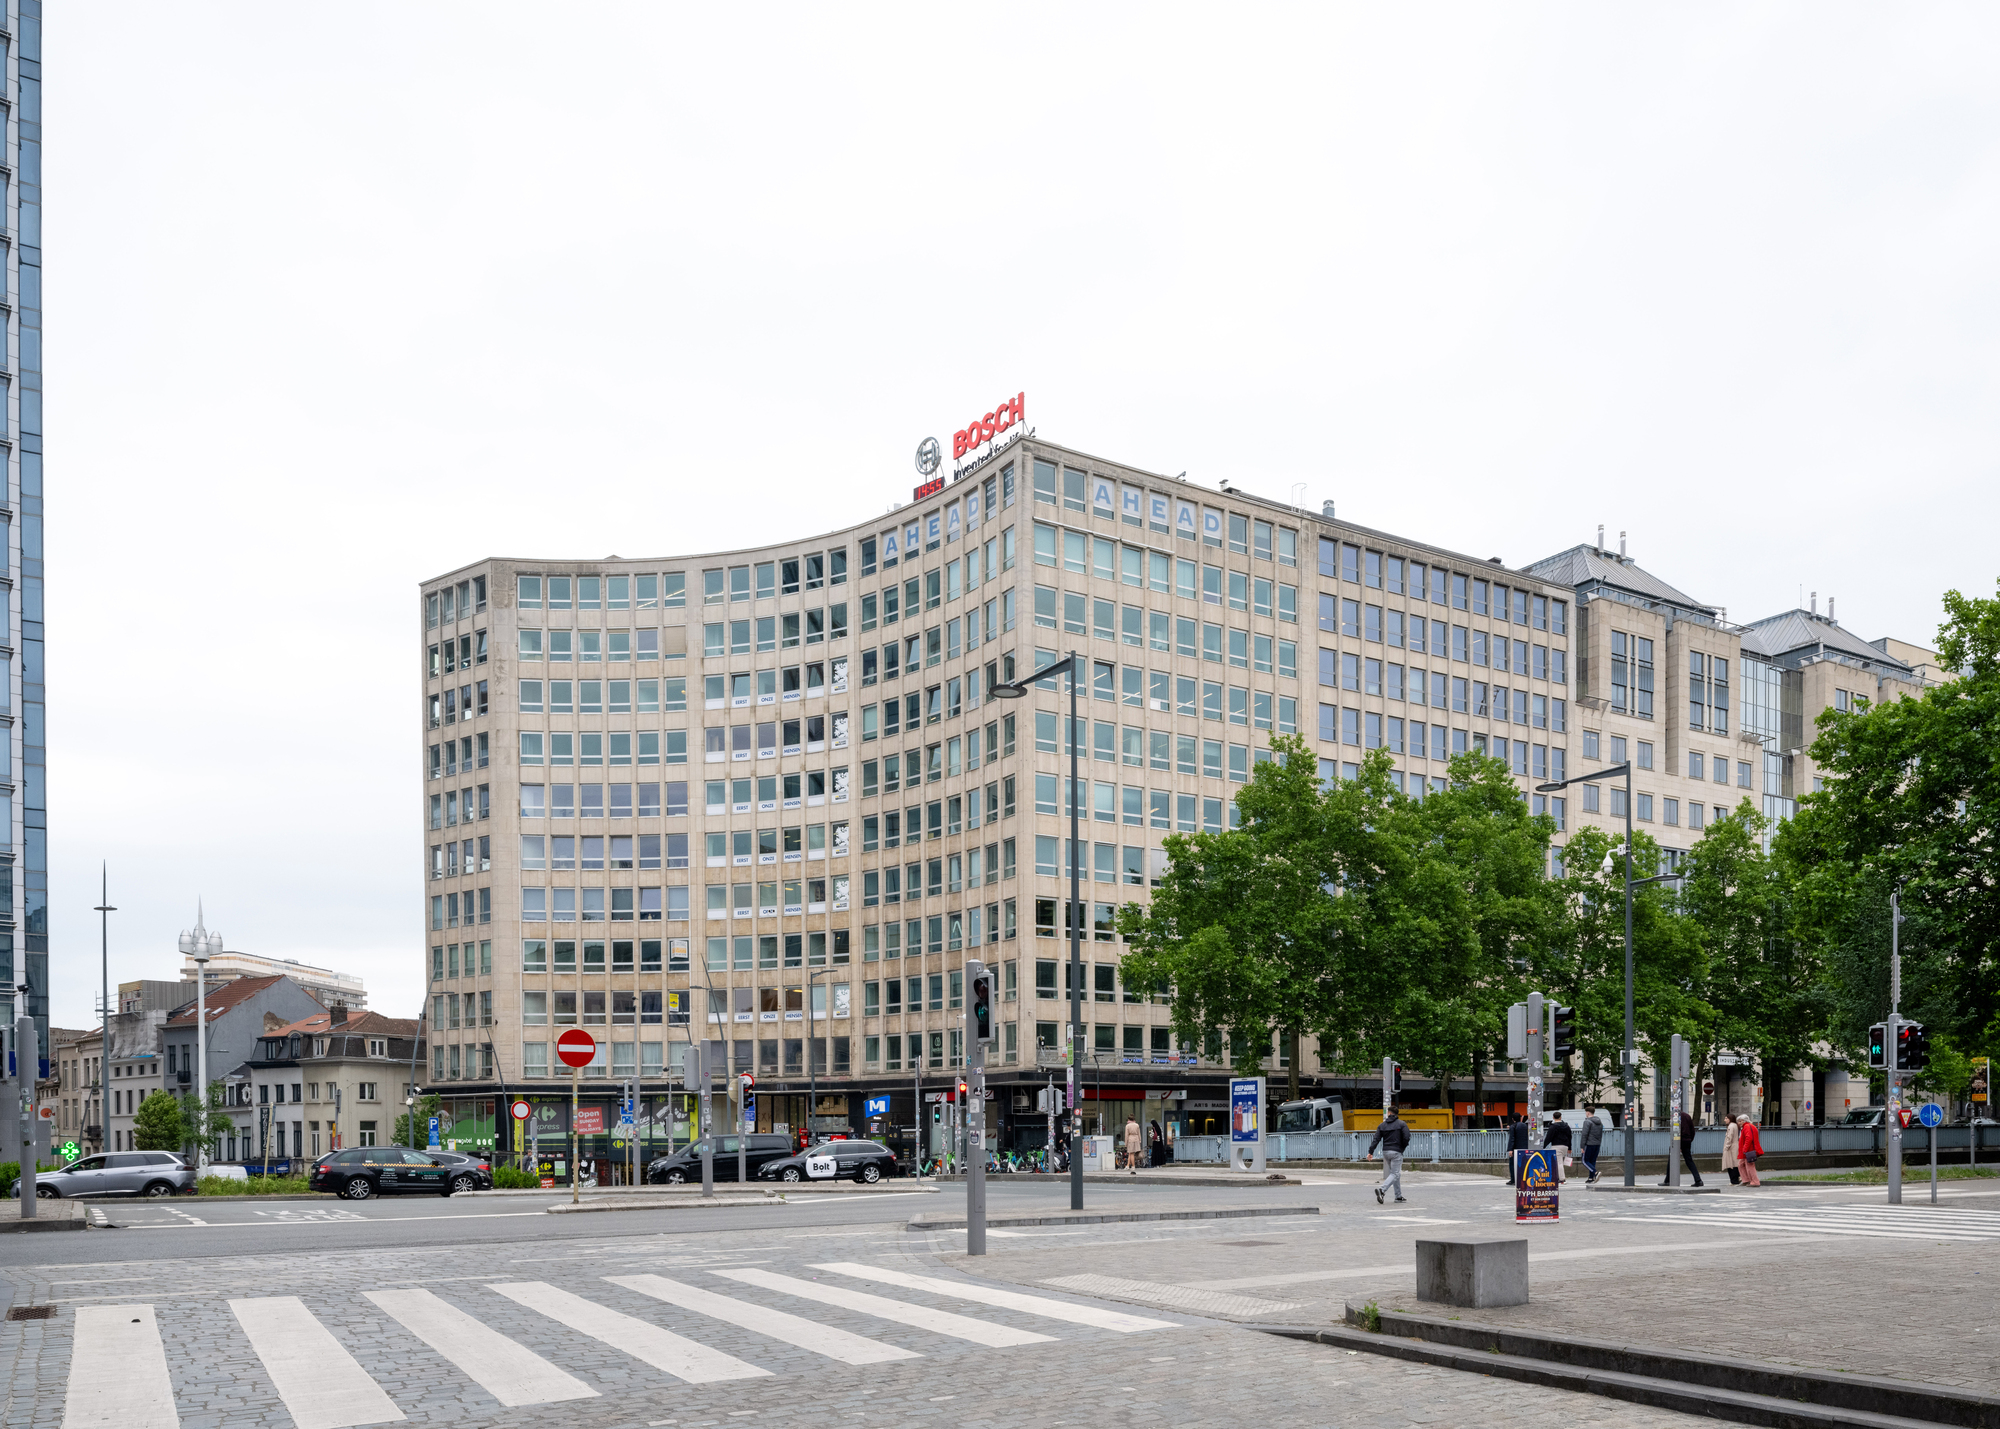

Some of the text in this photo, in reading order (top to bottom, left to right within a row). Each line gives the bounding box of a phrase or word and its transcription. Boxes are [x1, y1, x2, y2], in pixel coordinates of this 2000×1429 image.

[953, 391, 1024, 460] BOSCH
[917, 478, 942, 500] 14:55
[1094, 484, 1220, 532] AHEAD
[885, 496, 979, 556] AHEAD
[578, 1110, 600, 1118] Open
[430, 1119, 438, 1129] P
[536, 1123, 560, 1131] xpress
[813, 1163, 830, 1171] Bolt
[1533, 1169, 1550, 1178] Nuit
